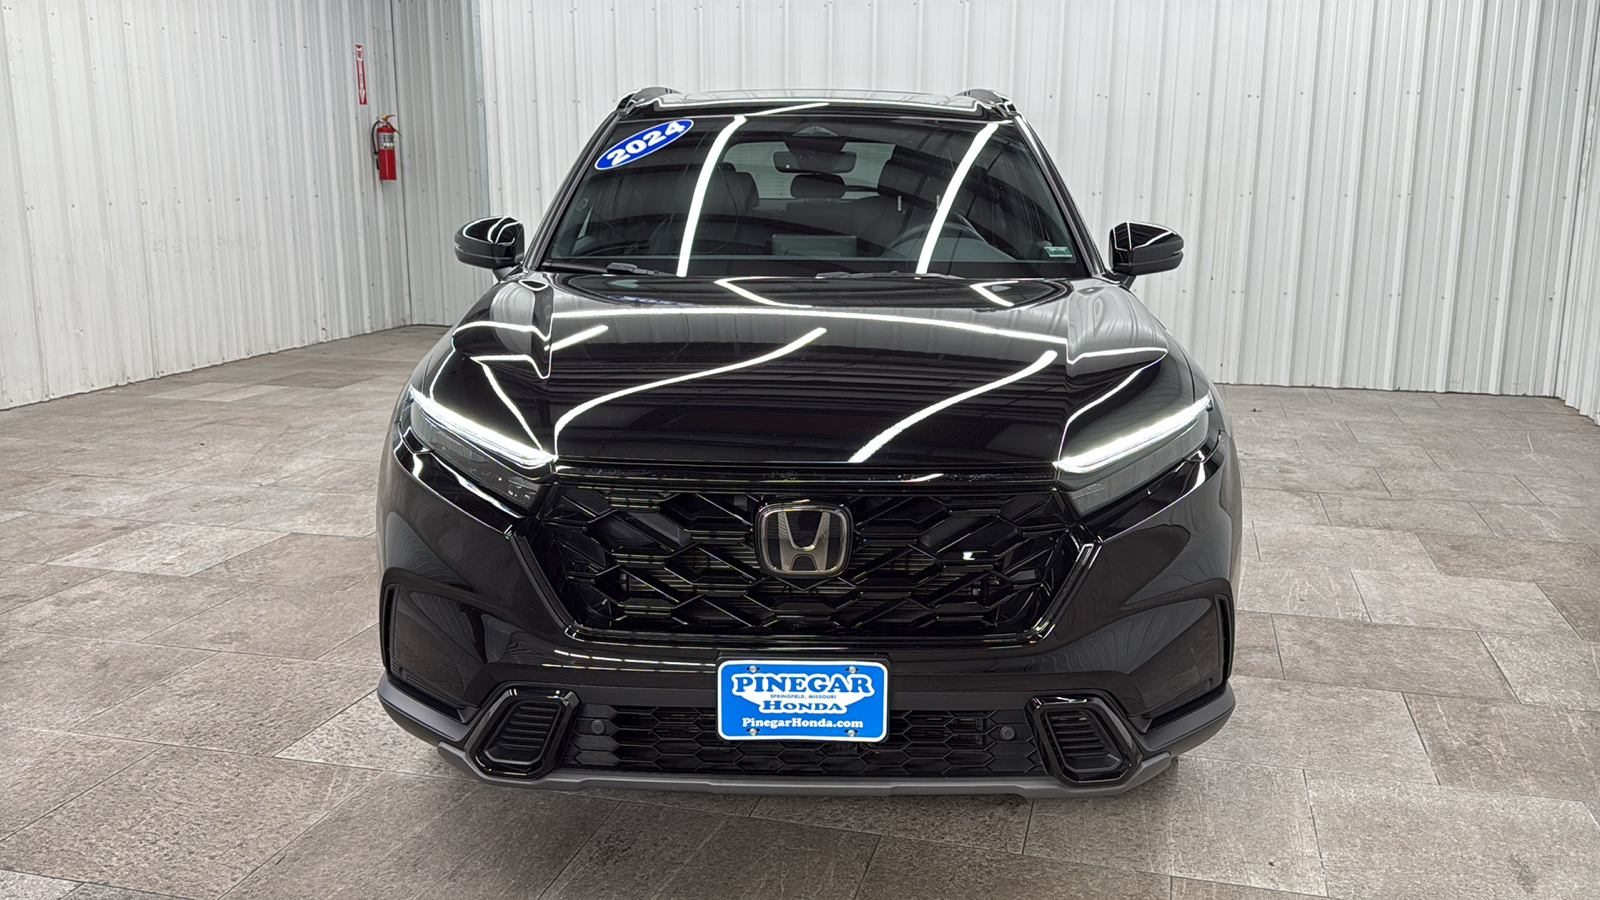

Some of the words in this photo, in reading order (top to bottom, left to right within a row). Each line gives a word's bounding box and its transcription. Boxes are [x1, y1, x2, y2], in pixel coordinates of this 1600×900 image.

[606, 121, 686, 166] 2024
[735, 676, 872, 693] PINEGAR
[742, 717, 863, 729] PinegarHonda.com
